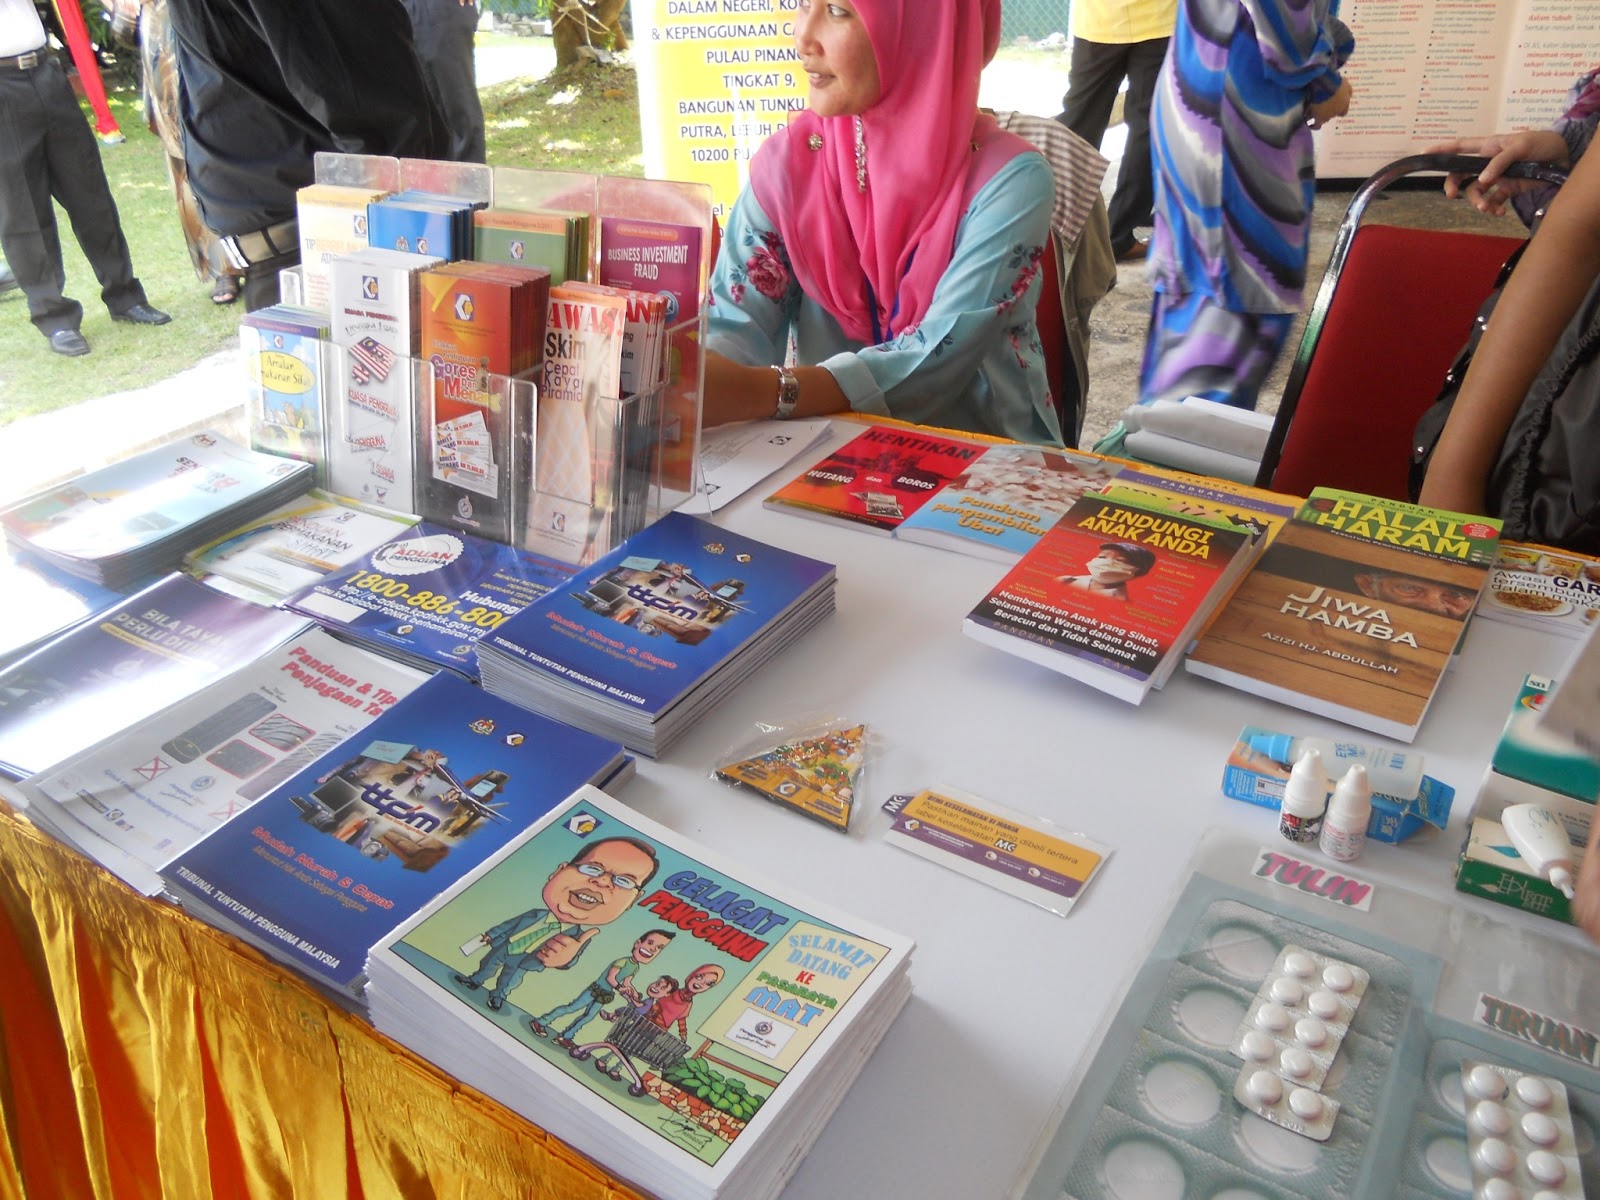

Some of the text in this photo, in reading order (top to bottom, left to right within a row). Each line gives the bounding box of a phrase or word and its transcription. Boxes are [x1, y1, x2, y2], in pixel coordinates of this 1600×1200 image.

[668, 0, 717, 14] DALAM
[722, 0, 774, 13] NEGERI,
[651, 31, 660, 40] &
[666, 23, 778, 39] KEPENGGUNAAN
[706, 50, 750, 64] PULAU
[723, 73, 796, 88] TINGKAT 9,
[679, 98, 806, 114] BANGUNAN TUNKU
[680, 126, 728, 139] PUTRA,
[691, 149, 729, 162] 10200
[712, 203, 723, 216] el
[607, 244, 689, 265] BUSINESS INVESTMENT
[633, 262, 659, 280] FRAUD
[546, 302, 623, 337] AWAS!
[545, 332, 586, 360] Skim
[430, 353, 477, 379] Gores
[862, 428, 978, 461] HENTIKAN
[806, 467, 936, 491] HUTANG dan BOROS
[1160, 479, 1225, 499] PANDUAN
[930, 502, 1047, 537] Pengambilan
[958, 495, 1042, 524] Panduan
[1330, 499, 1467, 541] HALAL
[1370, 497, 1436, 515] PANDUAN
[958, 516, 1005, 538] Ubat
[1077, 517, 1144, 542] ANAK
[1143, 532, 1211, 561] ANDA
[1096, 505, 1215, 545] LINDUNGI
[1316, 512, 1471, 560] HARAM
[395, 547, 454, 561] ADUAN
[1491, 583, 1546, 598] dalam
[1494, 570, 1547, 585] Awasi
[141, 608, 181, 631] BILA
[998, 590, 1069, 617] Membesarkan
[1069, 611, 1105, 627] Anak
[1098, 620, 1127, 637] yang
[1127, 627, 1160, 648] Sihat,
[1287, 585, 1392, 626] JIWA
[111, 612, 169, 641] PERLU
[988, 597, 1032, 617] Selamat
[1031, 609, 1053, 623] dan
[1053, 615, 1088, 632] Waras
[1088, 625, 1123, 645] dalam
[1123, 640, 1158, 657] Dunia
[993, 608, 1138, 662] Beracun dan Tidak Selamat
[1279, 601, 1419, 649] HAMBA
[992, 621, 1132, 672] PANDUAN CAP
[1261, 631, 1399, 675] AZIZI HJ. ABDULLAH
[287, 645, 356, 688] Panduan
[356, 682, 375, 696] &
[493, 636, 529, 657] TRIBUNAL
[527, 650, 566, 674] TUNTUTAN
[565, 669, 608, 692] PENGGUNA
[606, 686, 646, 706] MALAYSIA
[280, 660, 363, 711] Penjagaan
[361, 701, 385, 717] Ta
[884, 795, 906, 813] MC
[943, 797, 990, 823] KESELAMATAN
[915, 807, 938, 821] label
[937, 814, 995, 843] keselamatan
[994, 839, 1018, 852] MC
[921, 800, 960, 822] Pastikan
[959, 814, 996, 833] mainan
[994, 827, 1019, 843] yang
[1018, 837, 1046, 853] dibeli
[1045, 847, 1079, 866] tertera
[251, 825, 296, 858] Mudah
[295, 852, 338, 882] Murah
[352, 883, 395, 910] Cepat
[1255, 851, 1372, 906] TULIN
[175, 865, 215, 896] TRIBUNAL
[212, 885, 255, 922] TUNTUTAN
[252, 911, 300, 947] PENGGUNA
[296, 938, 342, 969] MALAYSIA
[663, 870, 790, 936] GELAGAT
[637, 889, 770, 963] PENGGUNA
[786, 948, 853, 981] DATANG
[787, 934, 876, 970] SELAMAT
[755, 970, 839, 1010] PASARAYA
[795, 970, 816, 986] KE
[743, 986, 825, 1028] MAT
[1480, 993, 1600, 1068] TIRUAN
